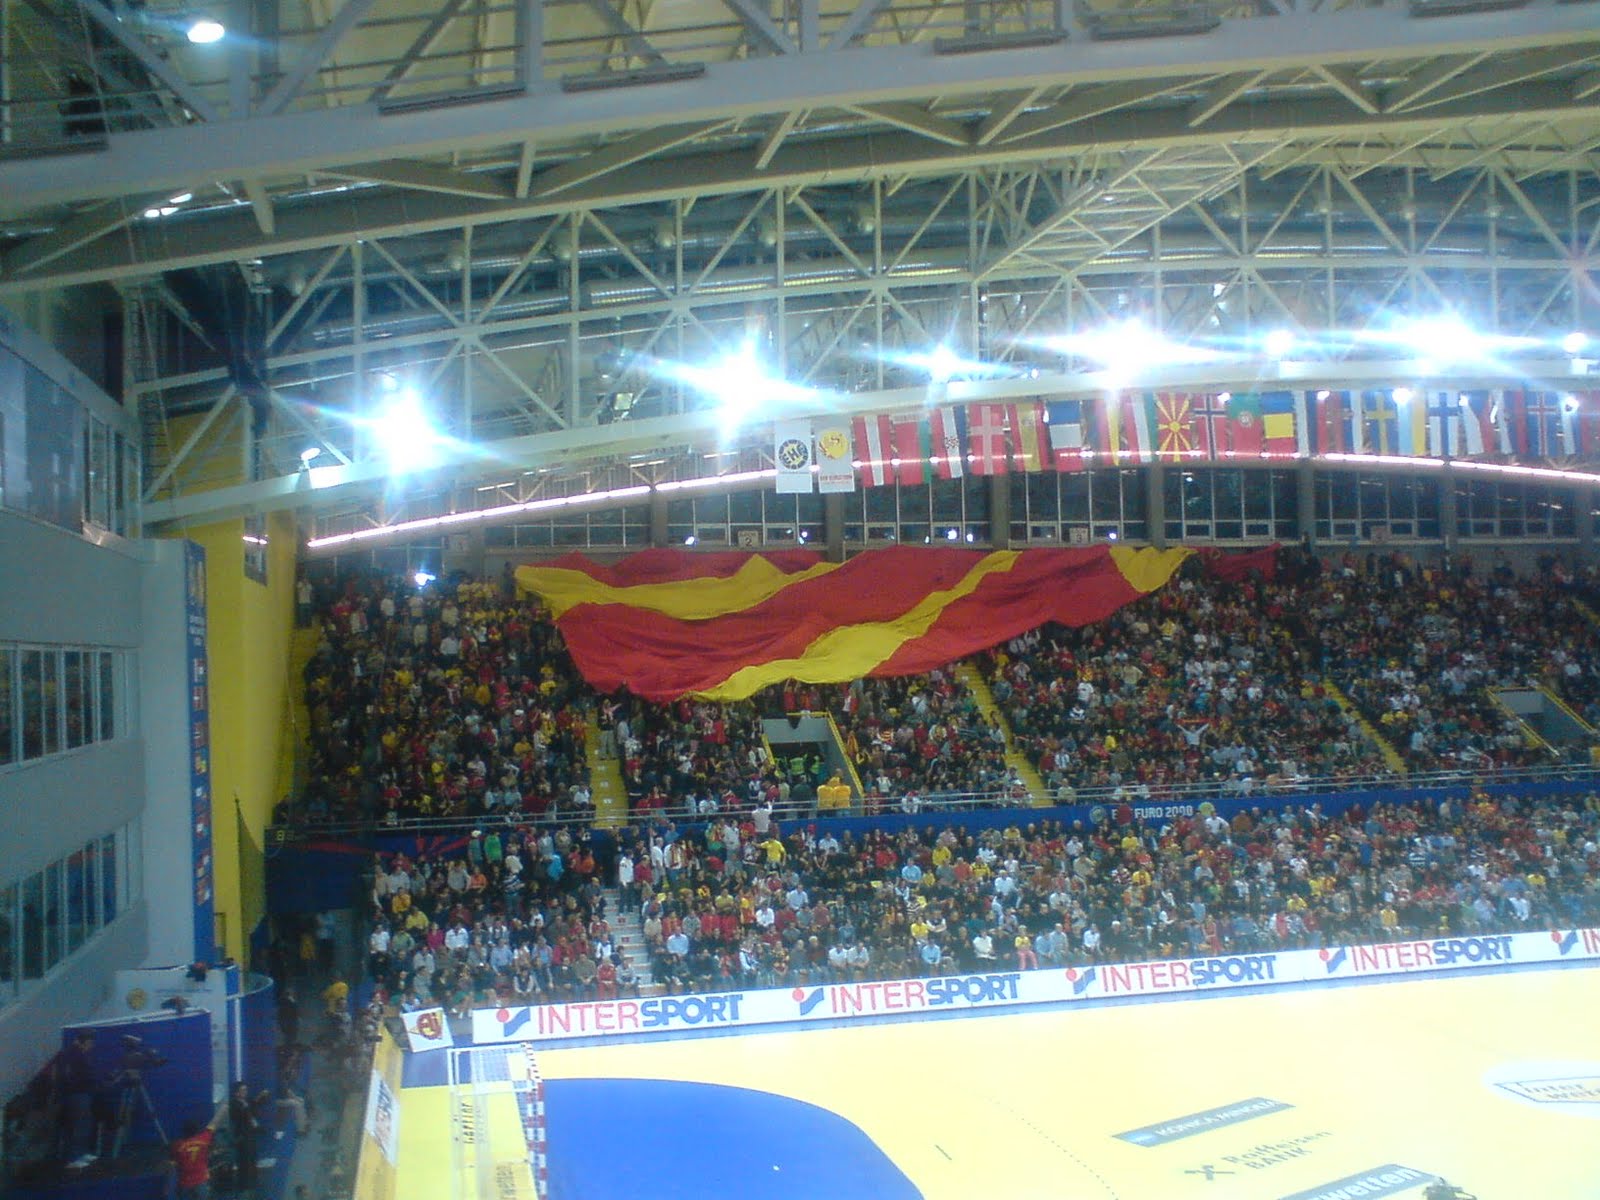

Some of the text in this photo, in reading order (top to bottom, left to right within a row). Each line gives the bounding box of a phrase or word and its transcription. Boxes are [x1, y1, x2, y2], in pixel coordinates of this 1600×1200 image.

[1351, 935, 1513, 972] INTERSPORT
[1102, 955, 1277, 992] INTERSPORT
[831, 973, 1020, 1014] INTERSPORT
[538, 993, 744, 1035] INTERSPORT
